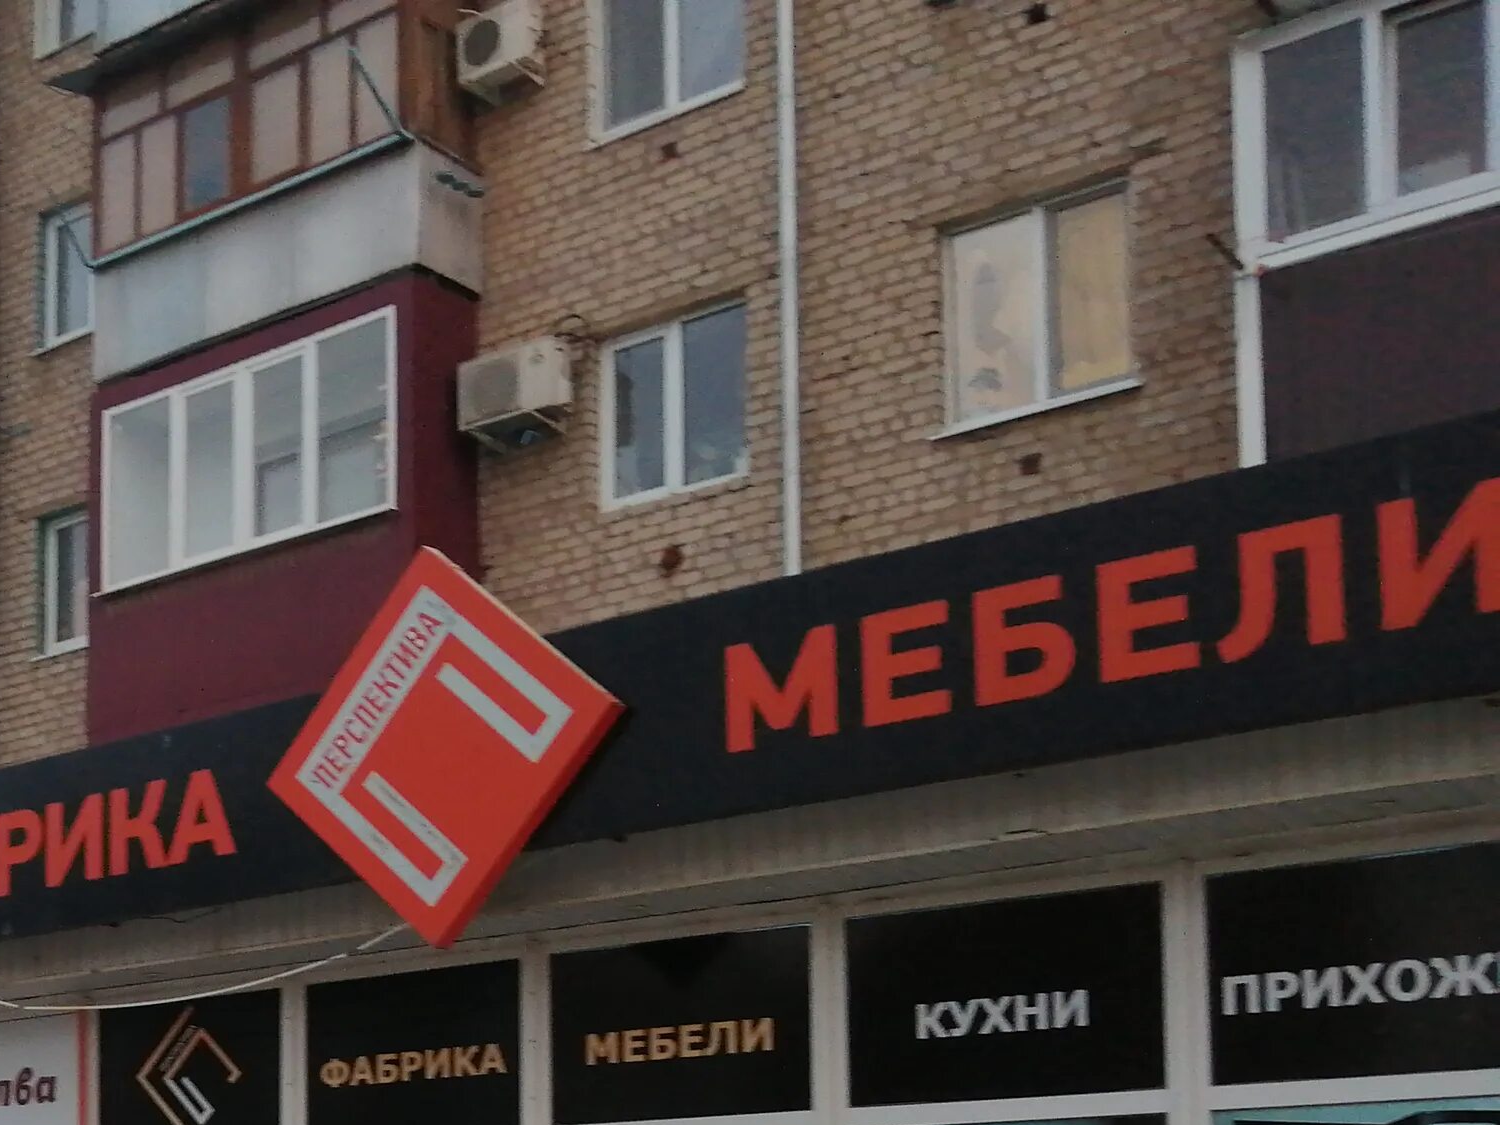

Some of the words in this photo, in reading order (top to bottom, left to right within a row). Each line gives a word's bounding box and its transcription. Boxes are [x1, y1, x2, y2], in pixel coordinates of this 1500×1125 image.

[724, 476, 1500, 754] МЕБЕЛИ
[312, 611, 442, 790] ПЕРСПЕКТИВА
[1221, 951, 1500, 1016] ПРИХОЖ
[584, 1016, 775, 1066] МЕБЕЛИ
[915, 988, 1090, 1040] КУХНИ
[319, 1042, 509, 1089] ФАБРИКА
